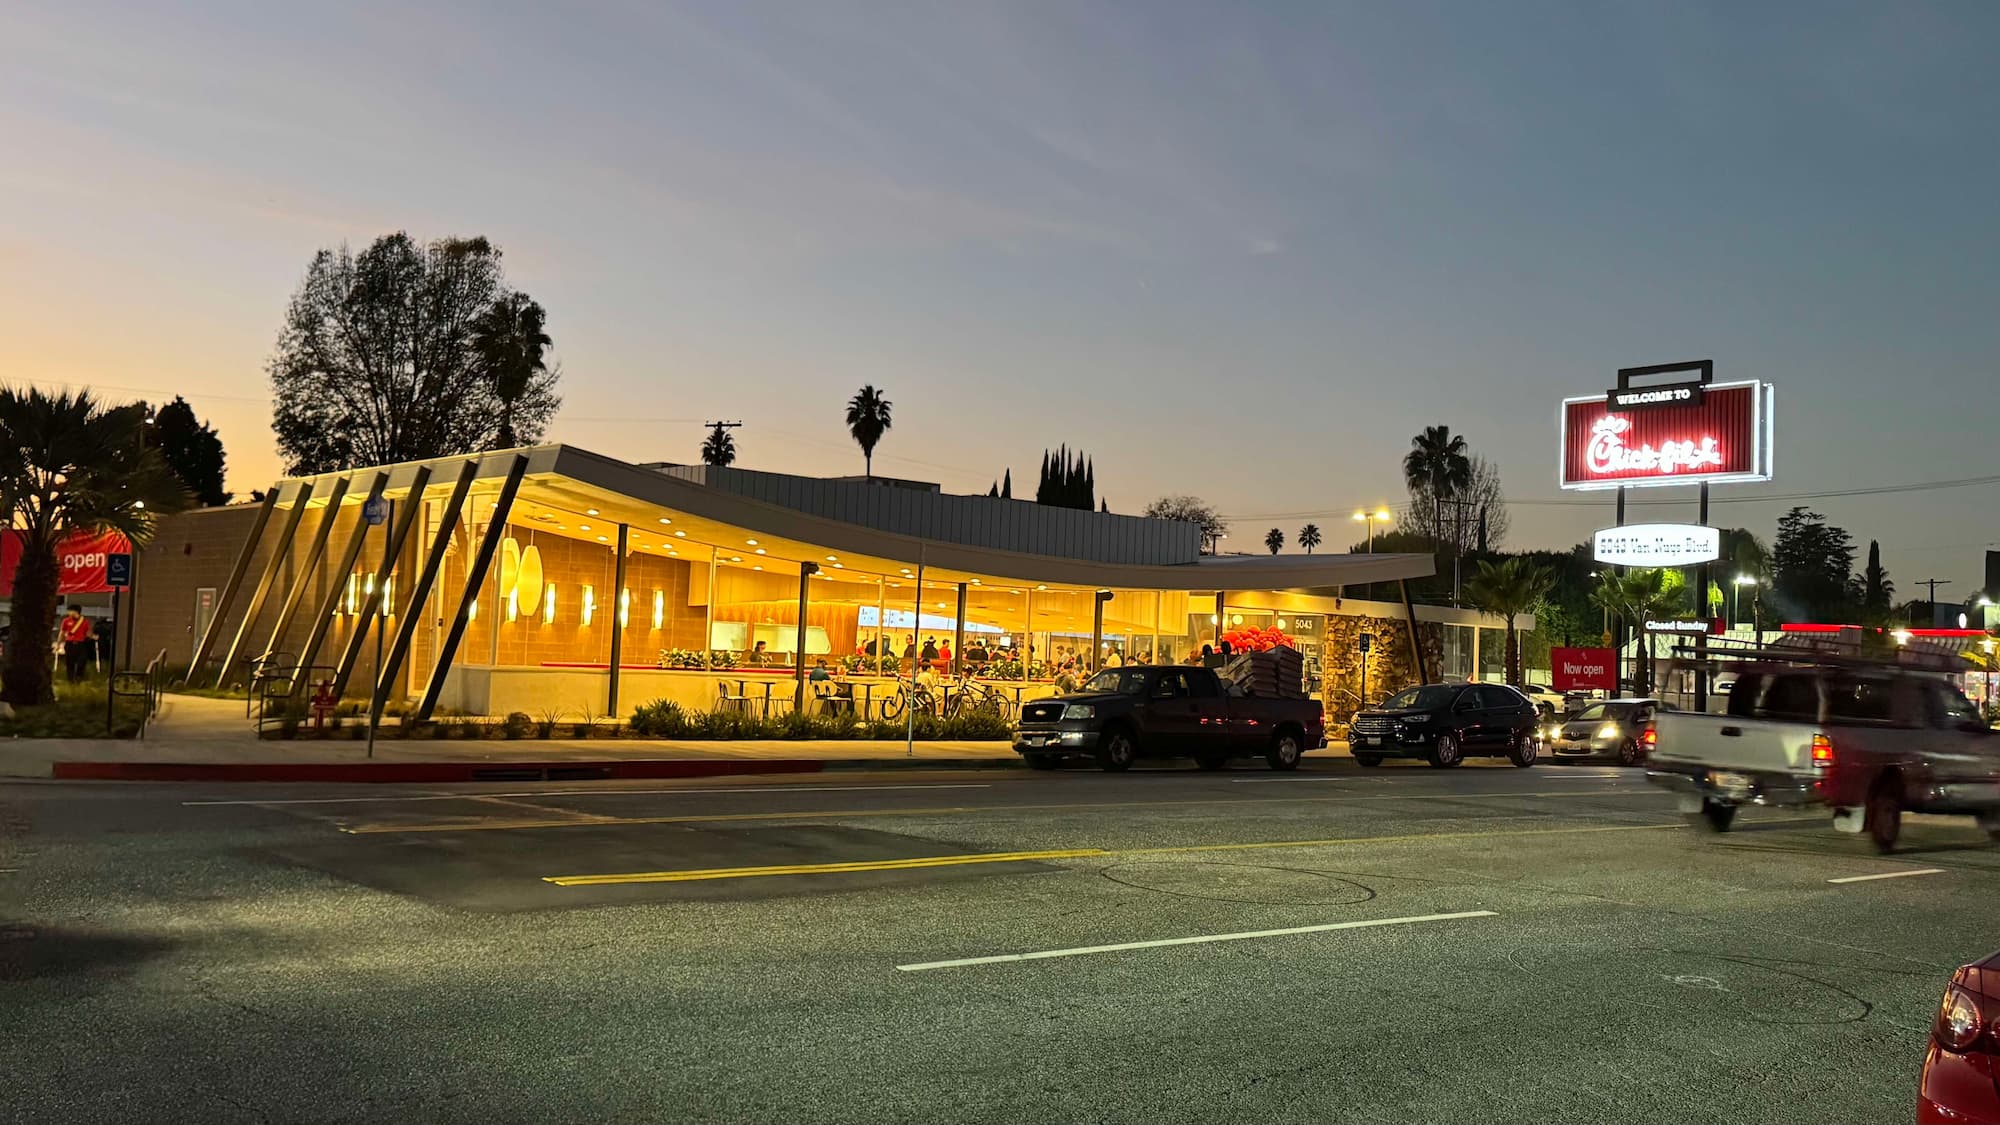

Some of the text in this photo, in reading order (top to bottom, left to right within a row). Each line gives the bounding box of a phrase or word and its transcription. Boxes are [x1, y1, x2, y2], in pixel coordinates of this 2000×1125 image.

[1616, 389, 1691, 405] WELCOME TO
[64, 552, 105, 573] open
[1295, 619, 1313, 630] 5043
[1645, 620, 1708, 632] Closed Sunday
[1563, 662, 1604, 677] Now open
